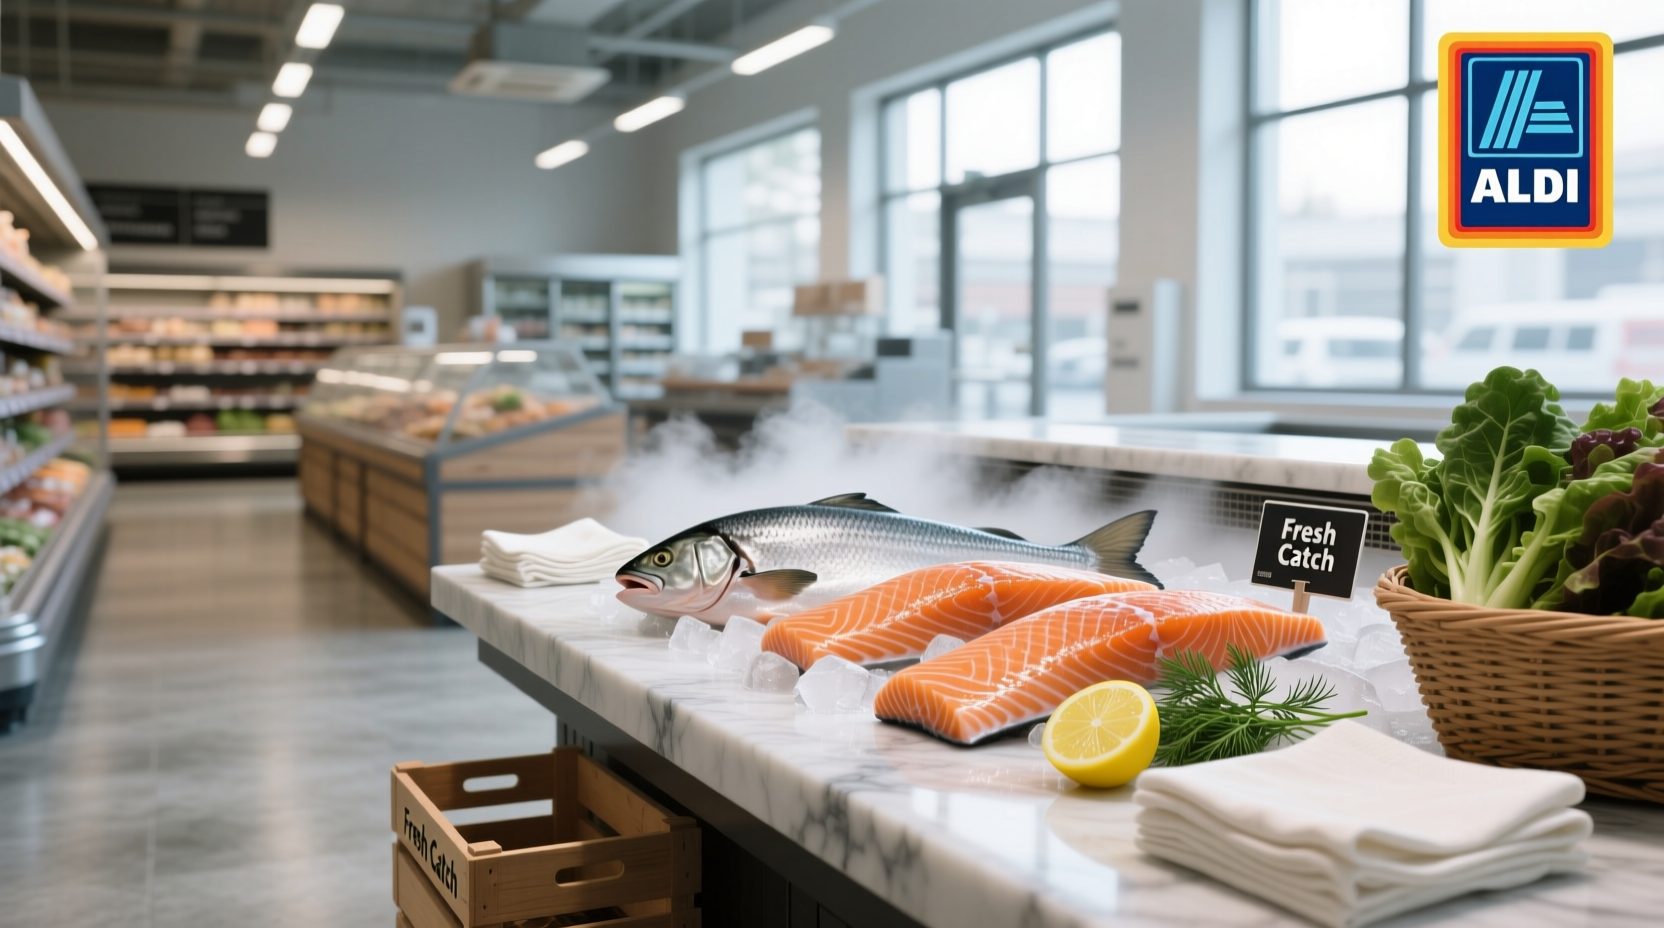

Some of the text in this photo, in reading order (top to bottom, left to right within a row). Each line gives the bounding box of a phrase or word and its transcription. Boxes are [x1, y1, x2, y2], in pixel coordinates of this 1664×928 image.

[1281, 517, 1336, 546] Fresh
[1277, 543, 1335, 572] Catch
[404, 806, 458, 899] Fresh Catch
